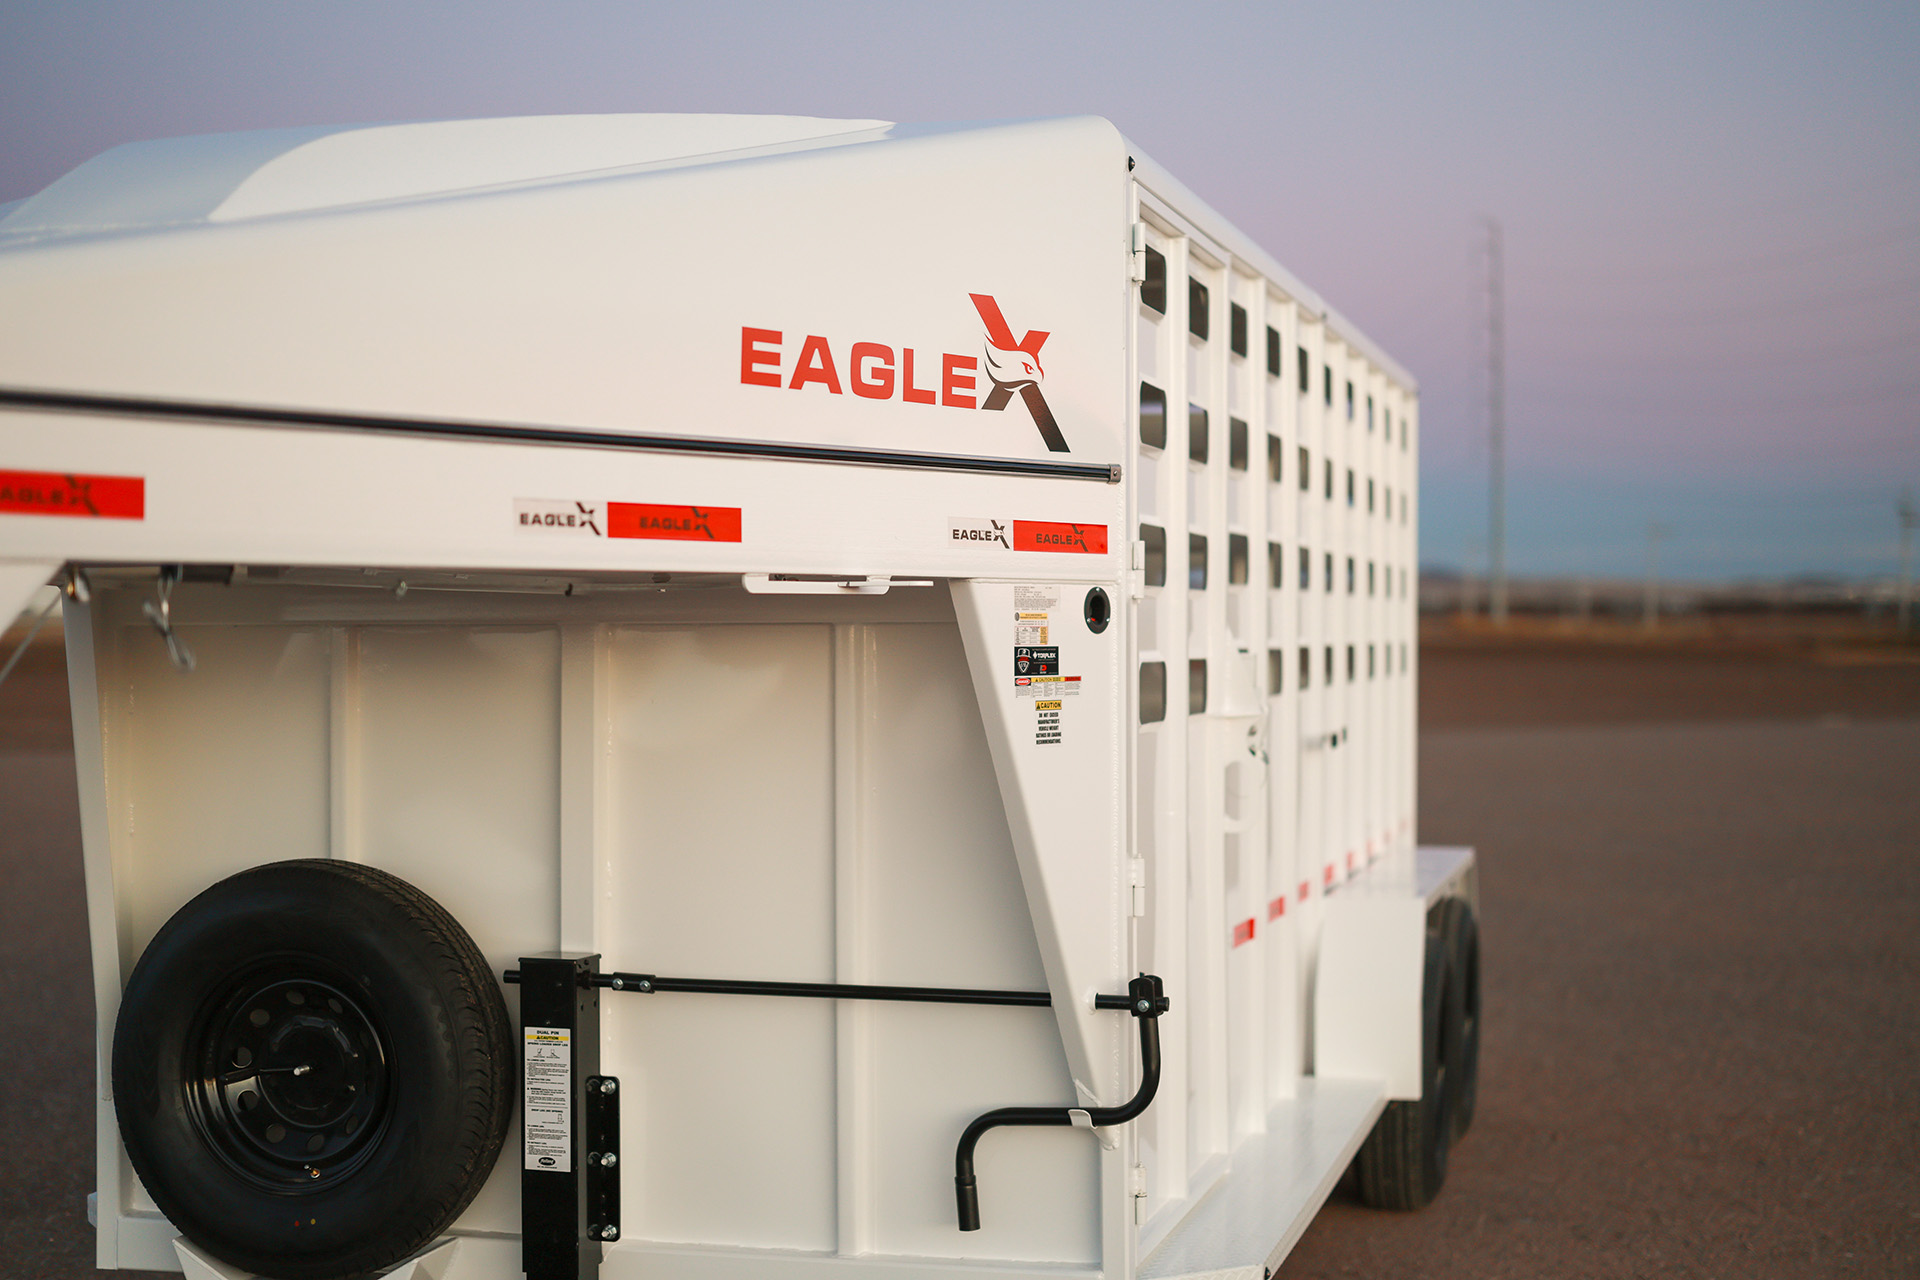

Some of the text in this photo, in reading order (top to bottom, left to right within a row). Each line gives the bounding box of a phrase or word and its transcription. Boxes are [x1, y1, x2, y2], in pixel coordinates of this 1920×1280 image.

[0, 475, 99, 516] AGLEX
[520, 501, 601, 536] EAGLEX
[640, 507, 714, 539] EAGLEX
[952, 520, 1010, 549] EAGLEX
[1036, 525, 1088, 552] EAGLEX
